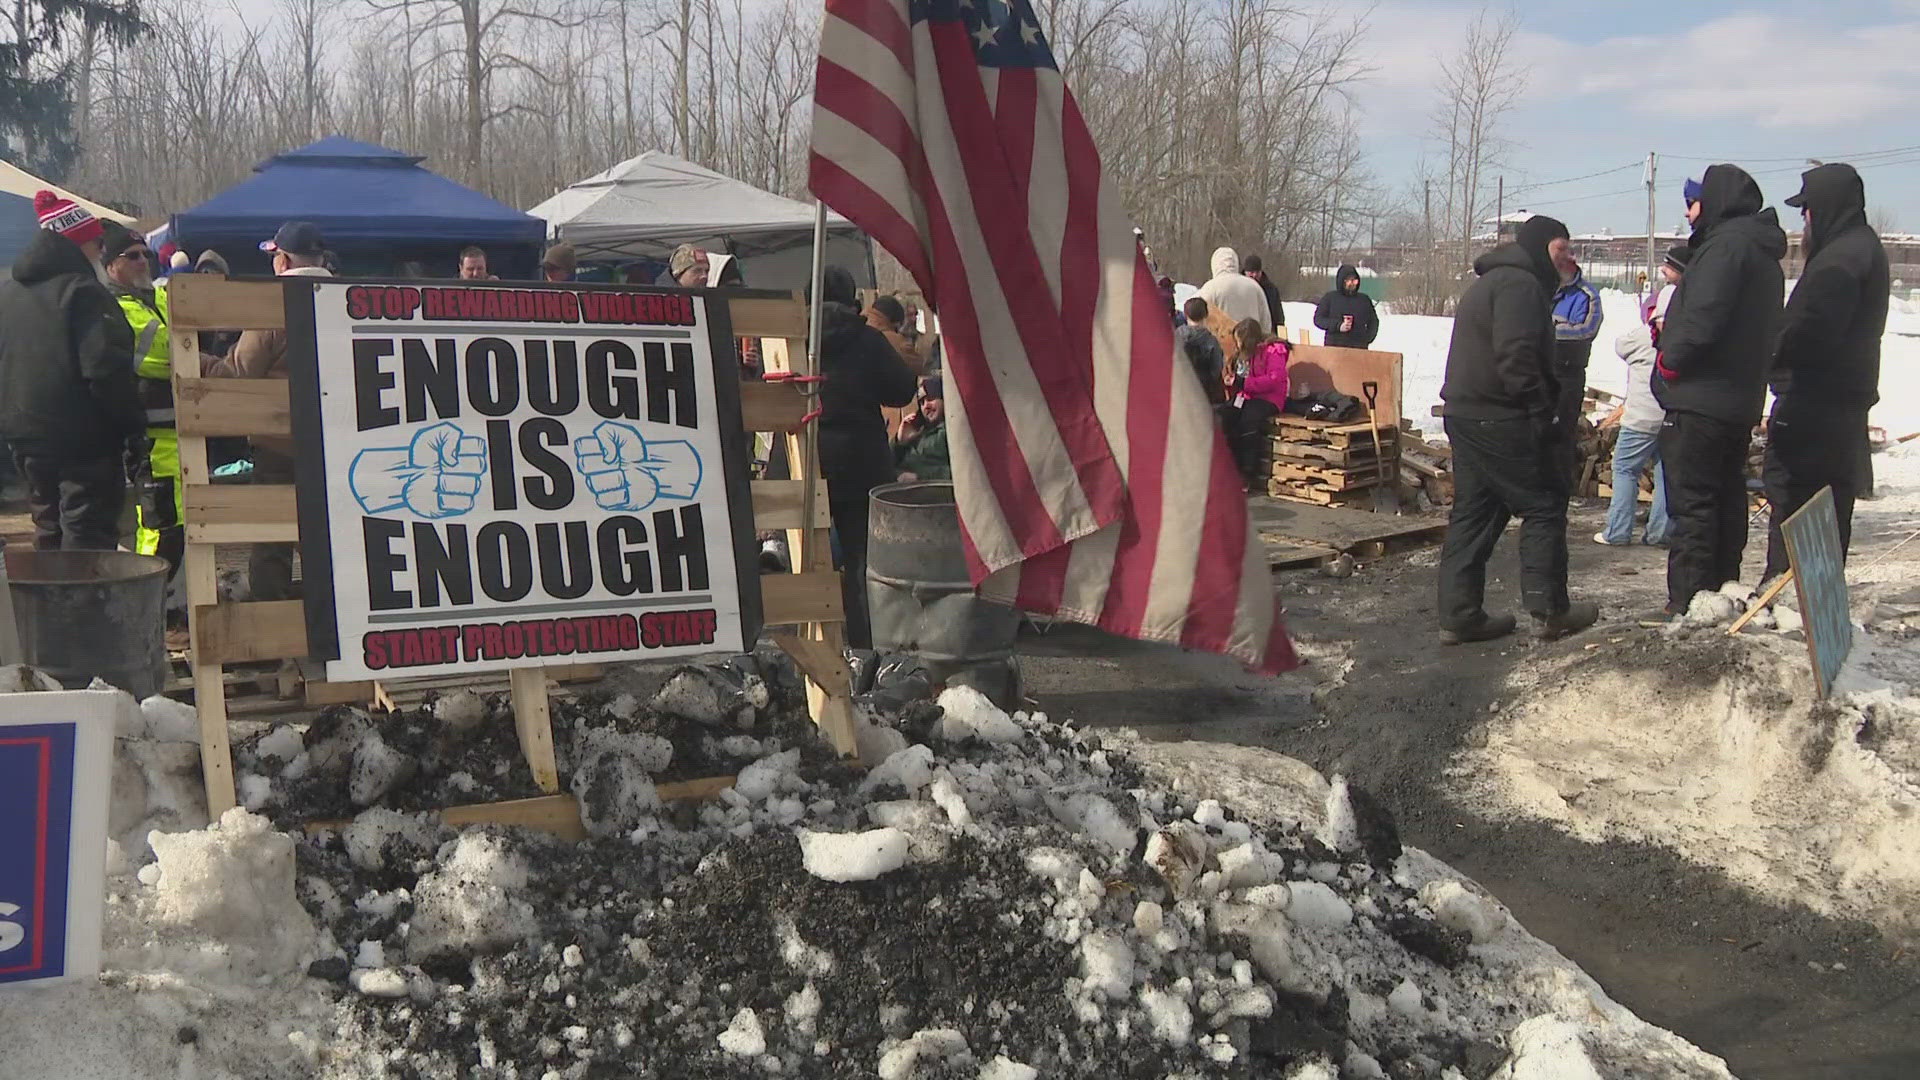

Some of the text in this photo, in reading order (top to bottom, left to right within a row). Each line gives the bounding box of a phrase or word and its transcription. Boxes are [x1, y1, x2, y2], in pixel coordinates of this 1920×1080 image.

[347, 287, 696, 325] STOP REWARDING VIOLENCE
[352, 338, 698, 432] ENOUGH
[486, 417, 574, 511] IS
[362, 504, 709, 611] ENOUGH
[364, 609, 717, 669] START PROTECTING STAFF
